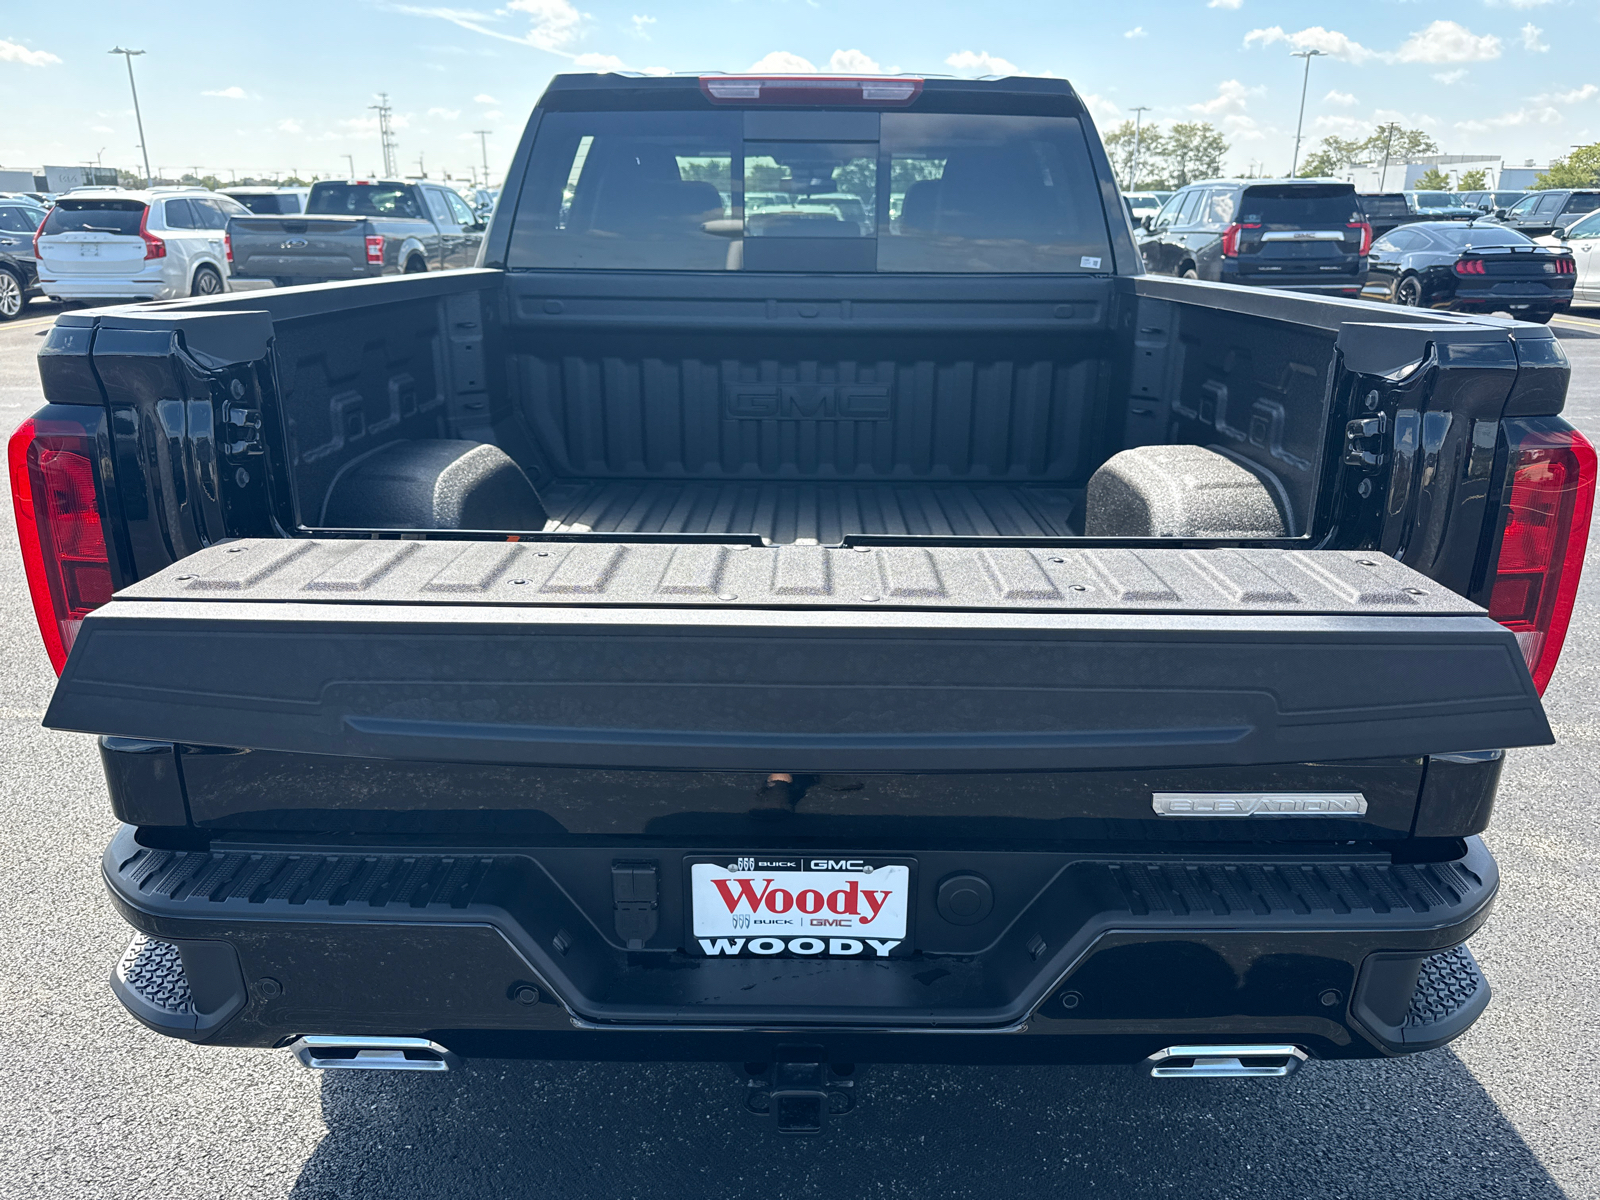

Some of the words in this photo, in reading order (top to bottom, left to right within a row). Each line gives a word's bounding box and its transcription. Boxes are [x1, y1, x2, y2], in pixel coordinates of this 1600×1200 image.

[727, 384, 889, 418] GMC
[1169, 799, 1350, 812] ELEVATION
[810, 860, 864, 870] GMC
[710, 878, 893, 924] Woody
[809, 918, 852, 927] GMC
[698, 937, 902, 957] WOODY
